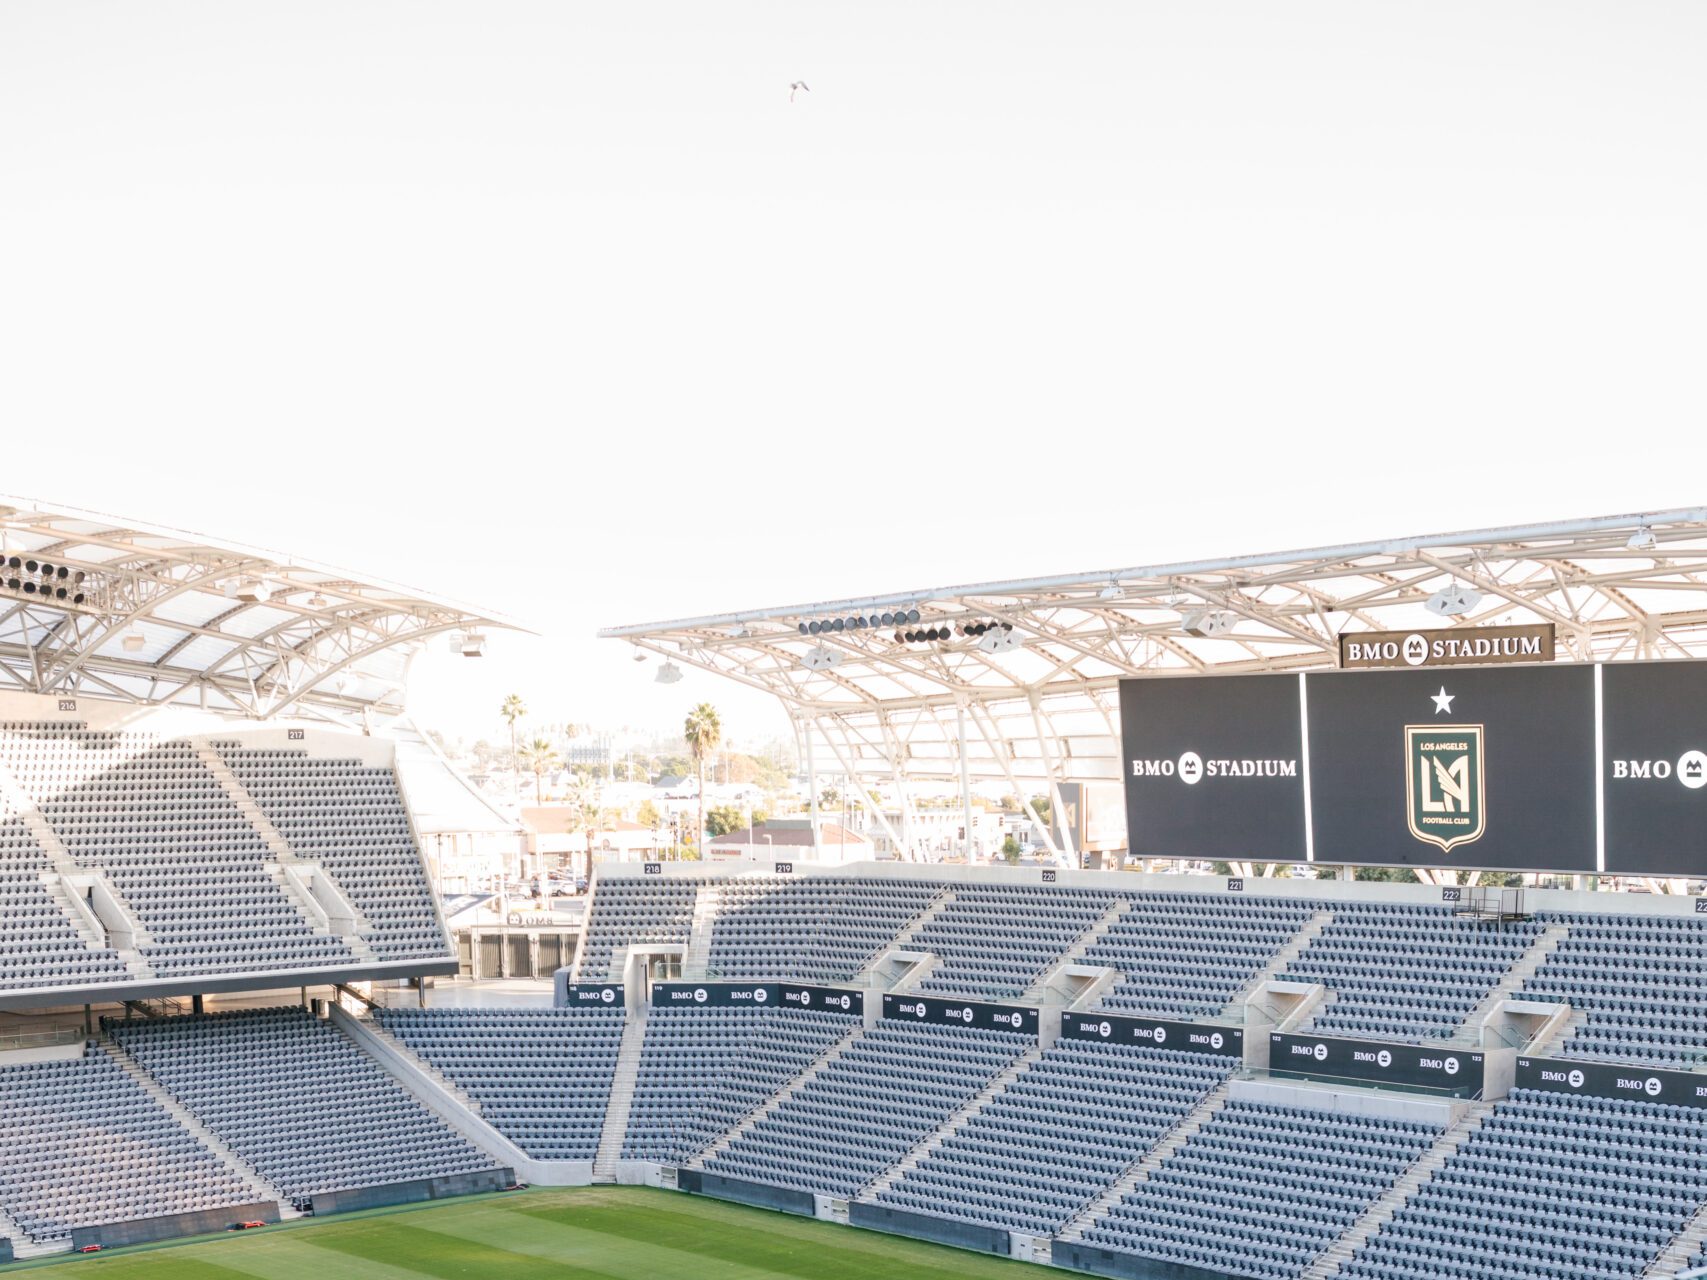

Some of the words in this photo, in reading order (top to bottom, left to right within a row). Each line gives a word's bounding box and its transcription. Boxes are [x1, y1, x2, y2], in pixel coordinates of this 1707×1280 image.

[1349, 642, 1399, 661] BMO
[1433, 636, 1542, 658] STADIUM
[1133, 760, 1174, 776] BMO
[1207, 760, 1296, 776] STADIUM
[1613, 760, 1671, 778] BMO
[1044, 873, 1055, 881] 220
[1230, 881, 1242, 890] 221
[579, 992, 600, 1000] BMO
[671, 992, 693, 1000] BMO
[786, 993, 800, 1001] BMO
[826, 997, 840, 1006] BMO
[899, 1005, 915, 1013] BMO
[946, 1010, 962, 1018] BMO
[994, 1014, 1010, 1023] BMO
[1080, 1023, 1098, 1033] BMO
[1134, 1029, 1152, 1038] BMO
[1190, 1035, 1209, 1044] BMO
[1291, 1046, 1312, 1056] BMO
[1354, 1052, 1376, 1062] BMO
[1419, 1059, 1442, 1069] BMO
[1541, 1071, 1567, 1082] BMO
[1617, 1079, 1643, 1090] BMO
